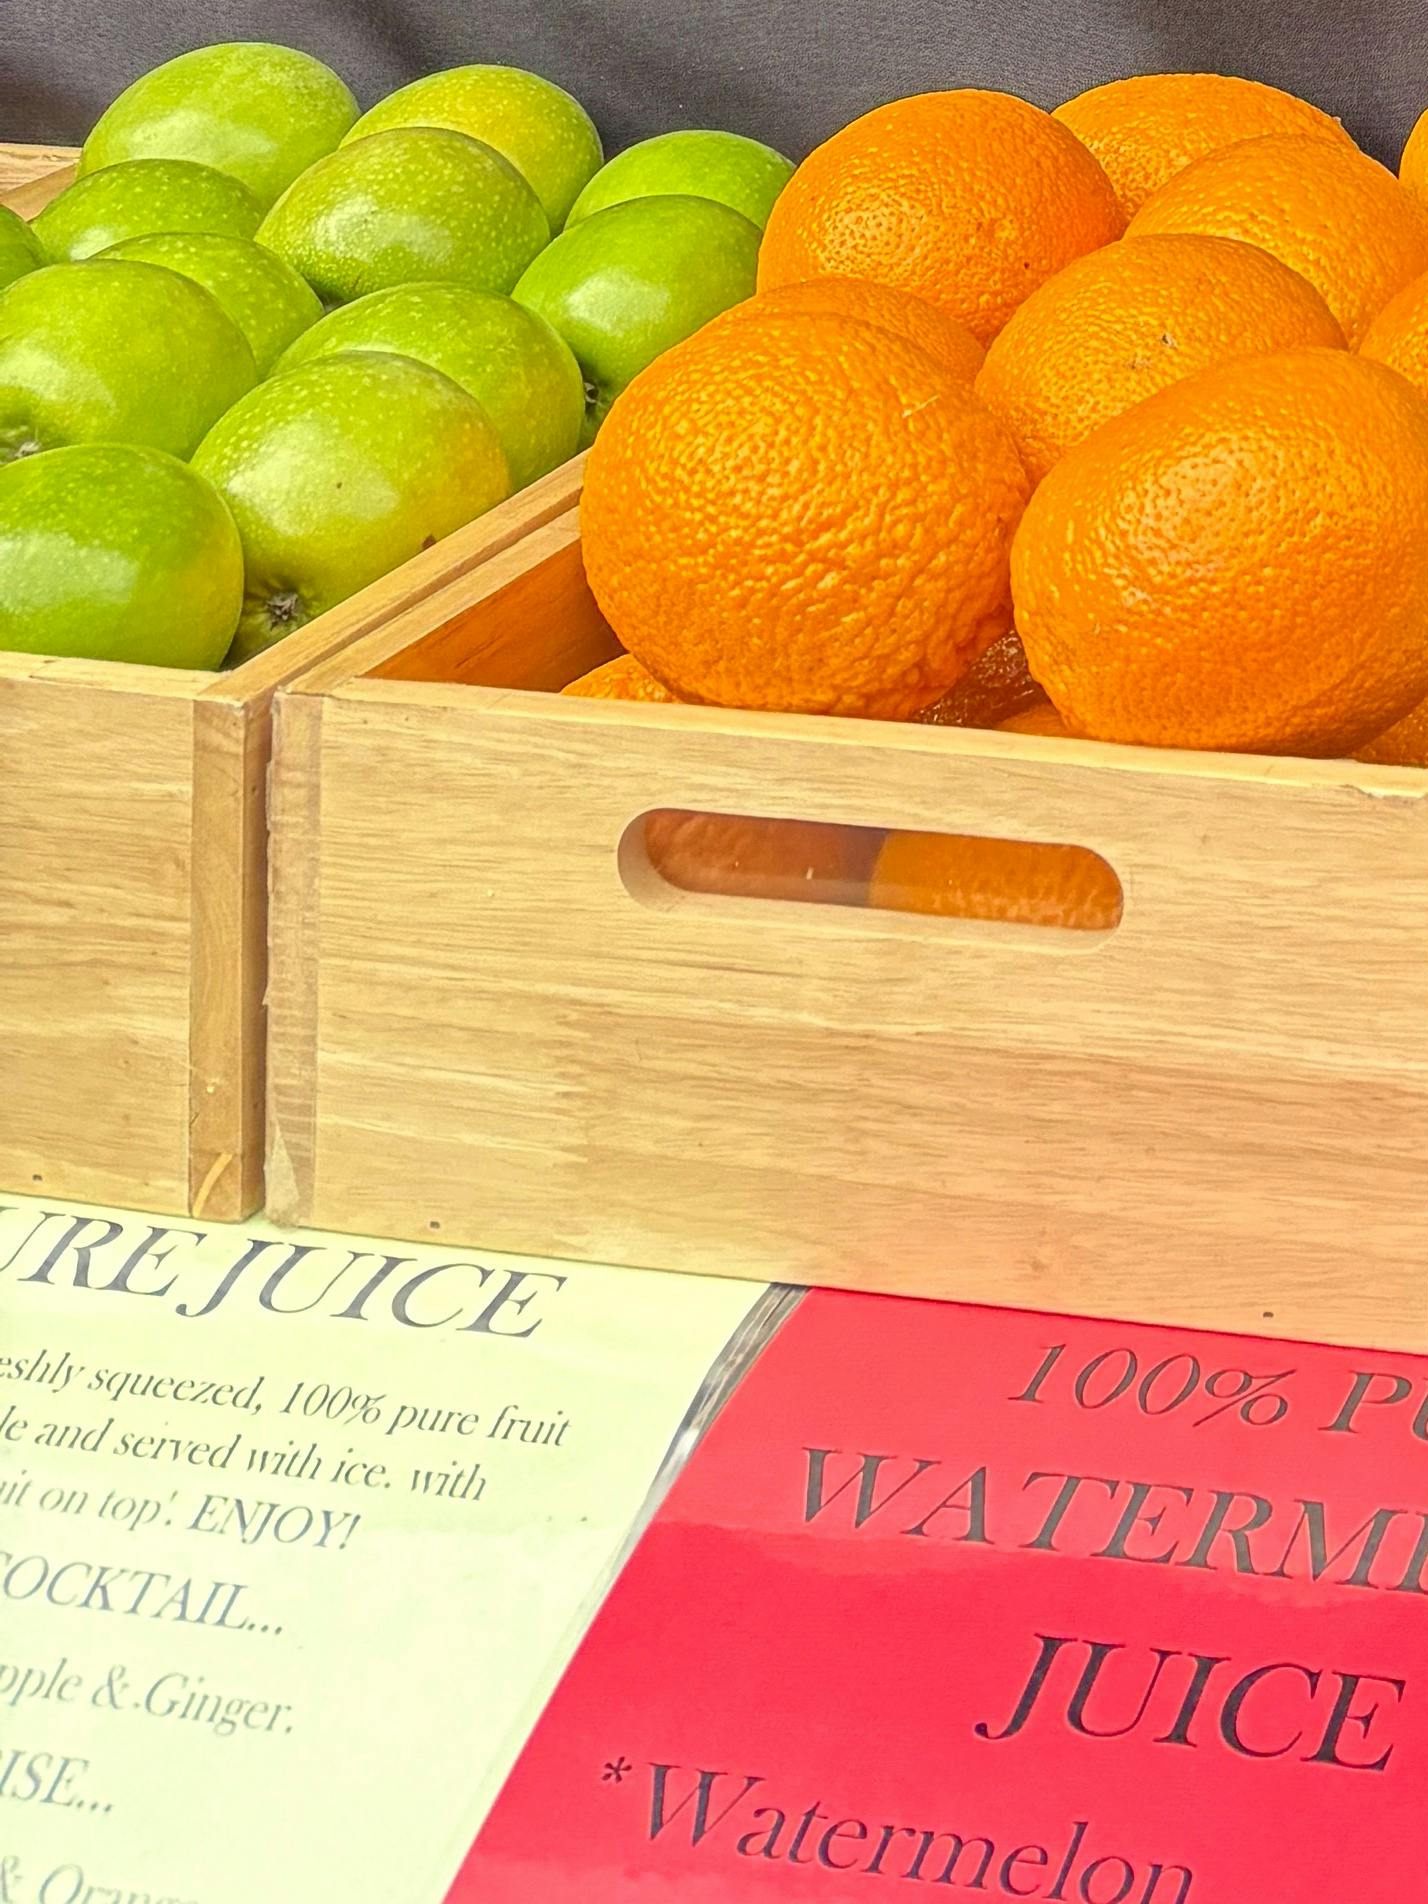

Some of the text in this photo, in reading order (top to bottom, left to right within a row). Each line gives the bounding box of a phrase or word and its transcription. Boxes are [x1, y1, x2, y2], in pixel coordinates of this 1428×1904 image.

[175, 1237, 568, 1339] JUICE
[87, 1366, 264, 1417] squeezed,
[279, 1379, 383, 1425] 100%
[386, 1400, 481, 1438] pure
[486, 1403, 573, 1450] fruit
[1007, 1337, 1294, 1428] 100%
[34, 1417, 115, 1453] and
[113, 1433, 242, 1470] served
[247, 1432, 323, 1481] with
[331, 1448, 392, 1491] ice.
[409, 1463, 488, 1503] with
[39, 1487, 89, 1515] on
[186, 1493, 363, 1552] ENJOY!
[0, 1549, 284, 1635] OCKTAIL...
[91, 1663, 129, 1710] &
[974, 1632, 1410, 1770] JUICE
